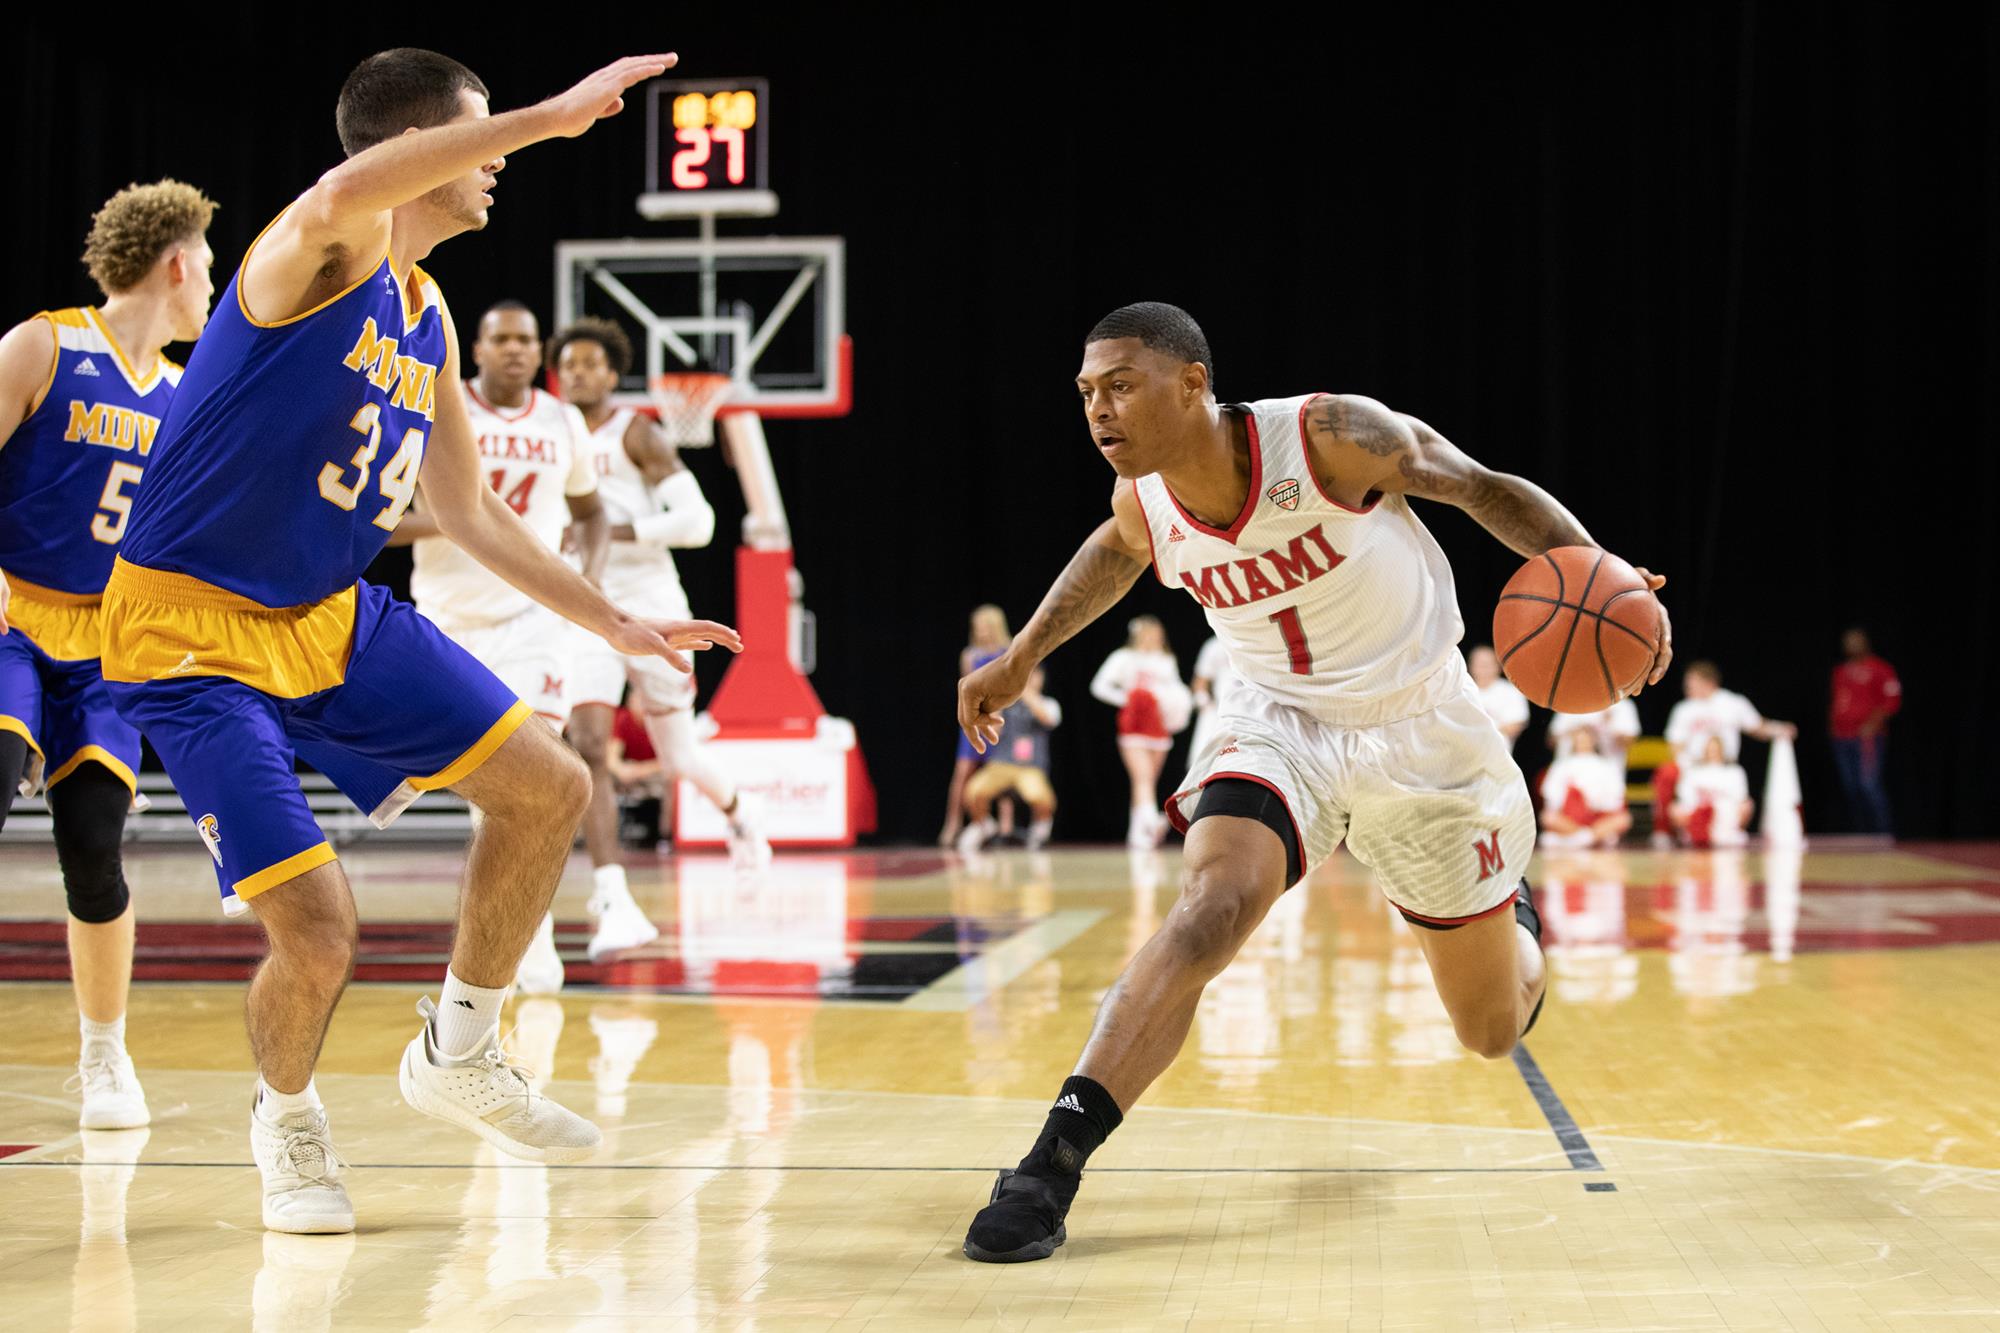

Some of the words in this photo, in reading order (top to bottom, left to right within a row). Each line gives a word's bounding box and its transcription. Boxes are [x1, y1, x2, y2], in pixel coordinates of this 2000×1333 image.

[672, 127, 745, 189] 27
[317, 401, 424, 532] 34
[1272, 484, 1299, 504] MAC
[91, 461, 144, 545] 5
[1179, 523, 1347, 608] MIAMI
[1269, 606, 1313, 676] 1
[541, 672, 564, 699] M
[1472, 827, 1505, 884] M
